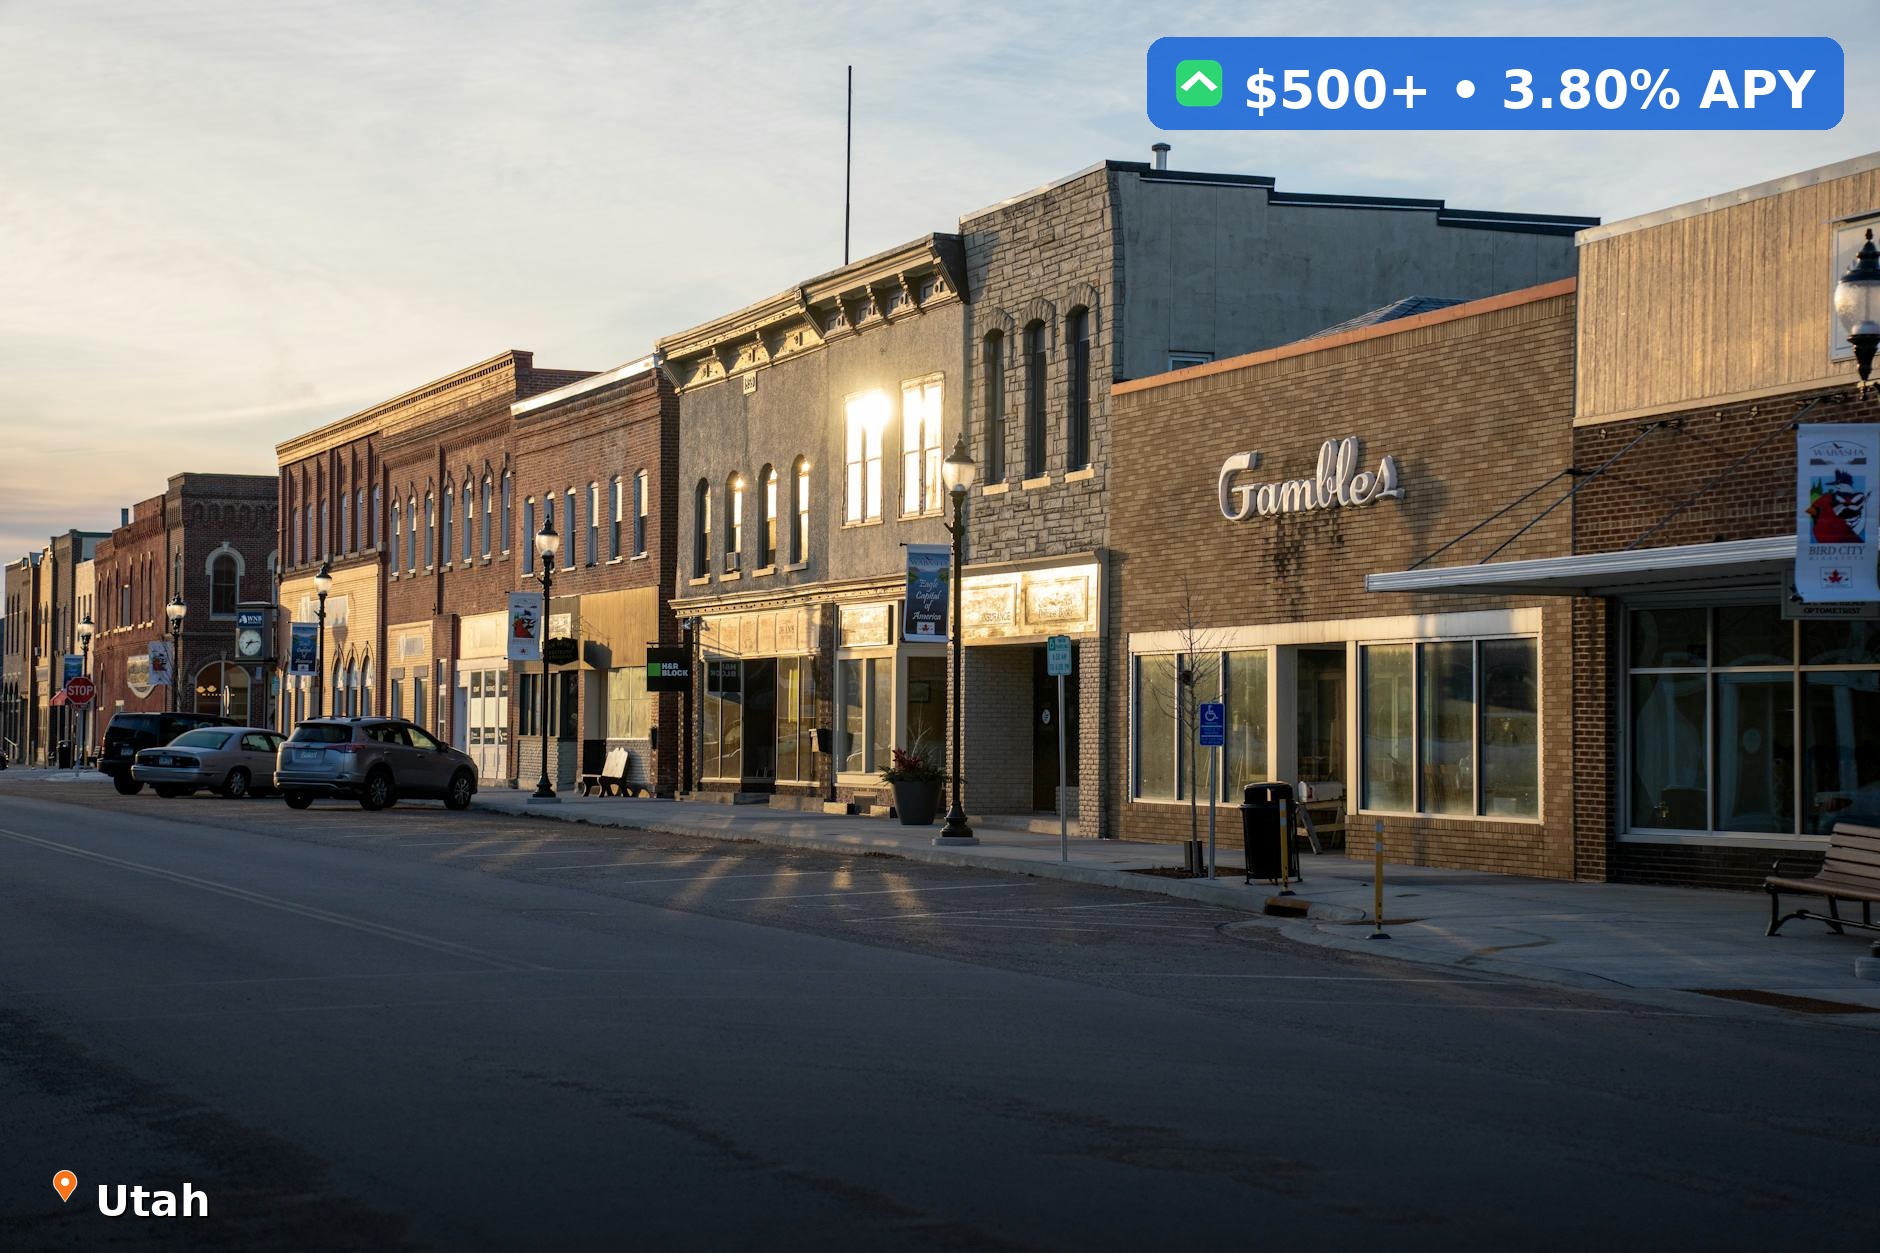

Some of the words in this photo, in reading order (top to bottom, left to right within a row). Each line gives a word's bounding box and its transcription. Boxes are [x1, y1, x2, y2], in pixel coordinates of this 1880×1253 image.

[1813, 447, 1866, 457] WABASHA
[1218, 436, 1406, 522] Gambles
[1809, 545, 1837, 556] BIRD
[1838, 545, 1866, 555] CITY
[919, 579, 938, 592] Eagle
[915, 590, 942, 603] Capital
[924, 600, 933, 612] of
[912, 610, 942, 620] America
[661, 669, 688, 677] BLOCK
[67, 685, 94, 696] STOP
